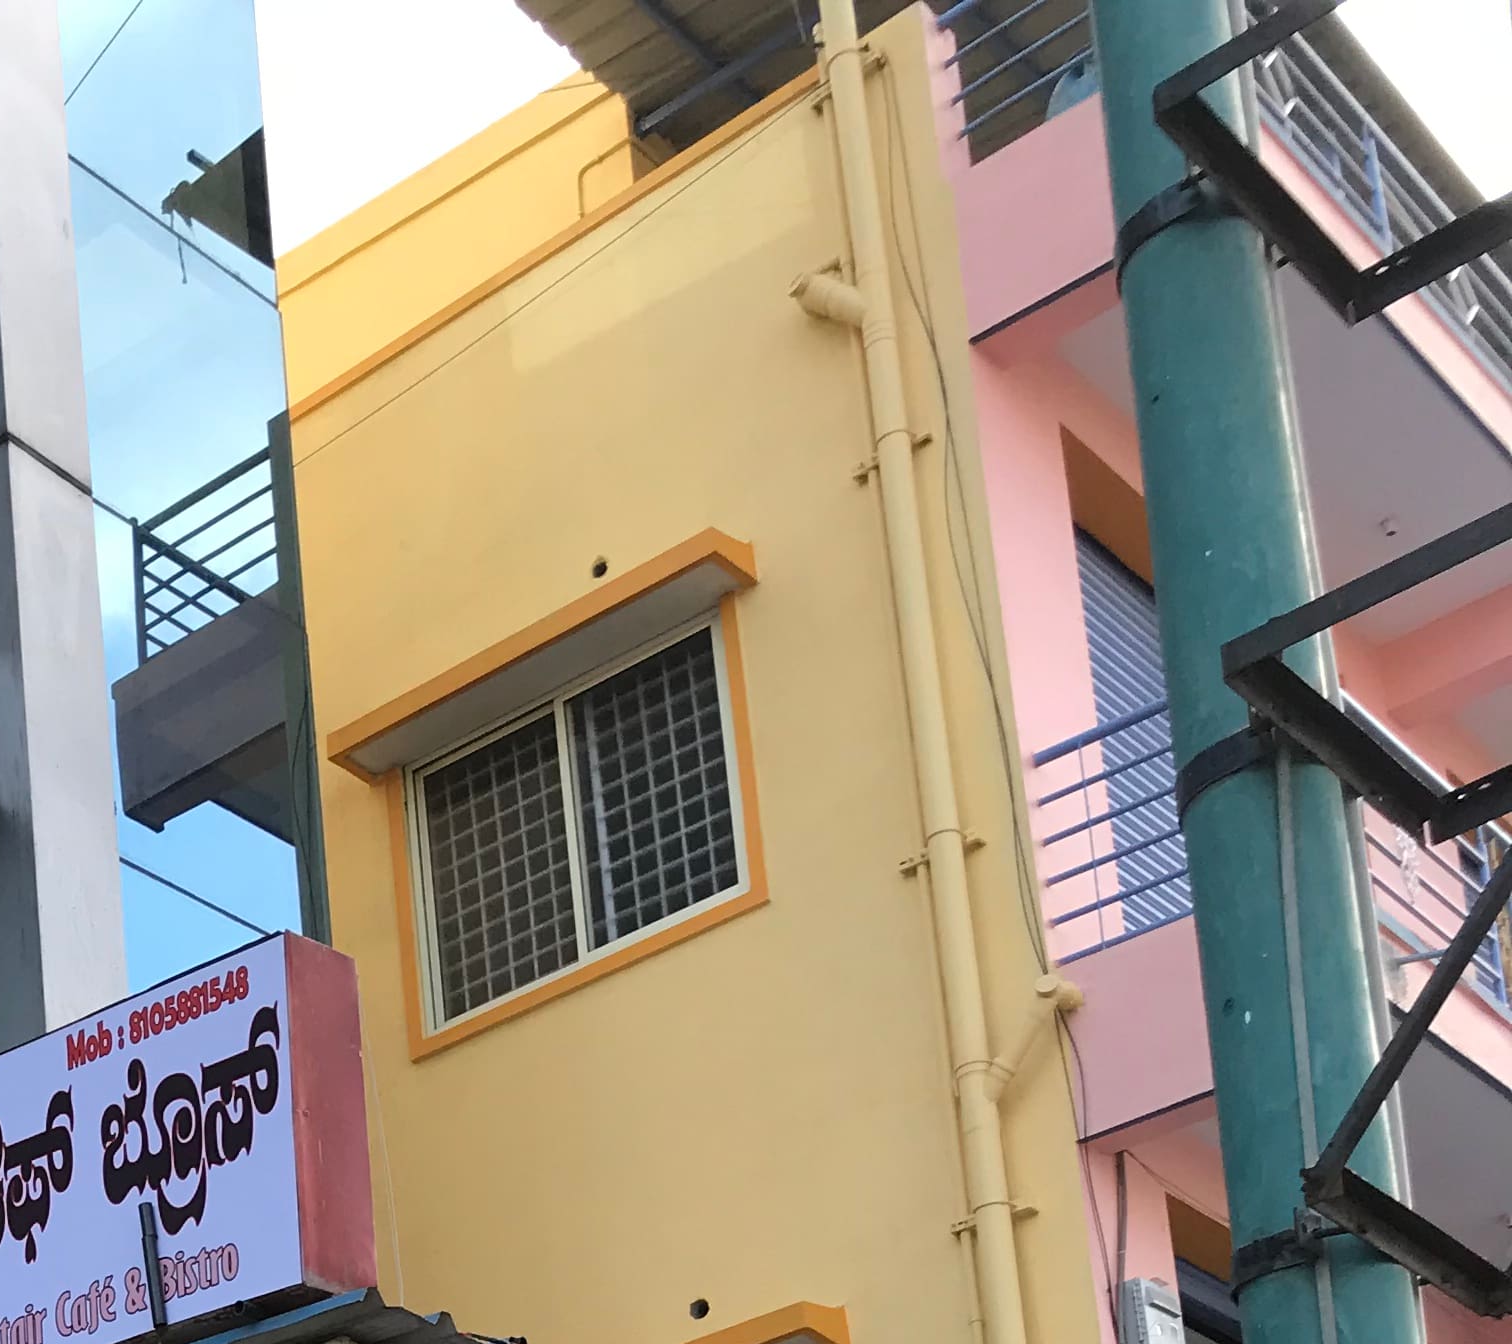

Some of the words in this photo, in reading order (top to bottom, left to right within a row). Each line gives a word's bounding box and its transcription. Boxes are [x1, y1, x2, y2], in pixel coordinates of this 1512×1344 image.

[66, 1021, 112, 1071] Mob
[129, 966, 249, 1044] 8105881548
[55, 1276, 116, 1336] Café
[124, 1267, 147, 1315] &
[159, 1243, 240, 1303] Bistro
